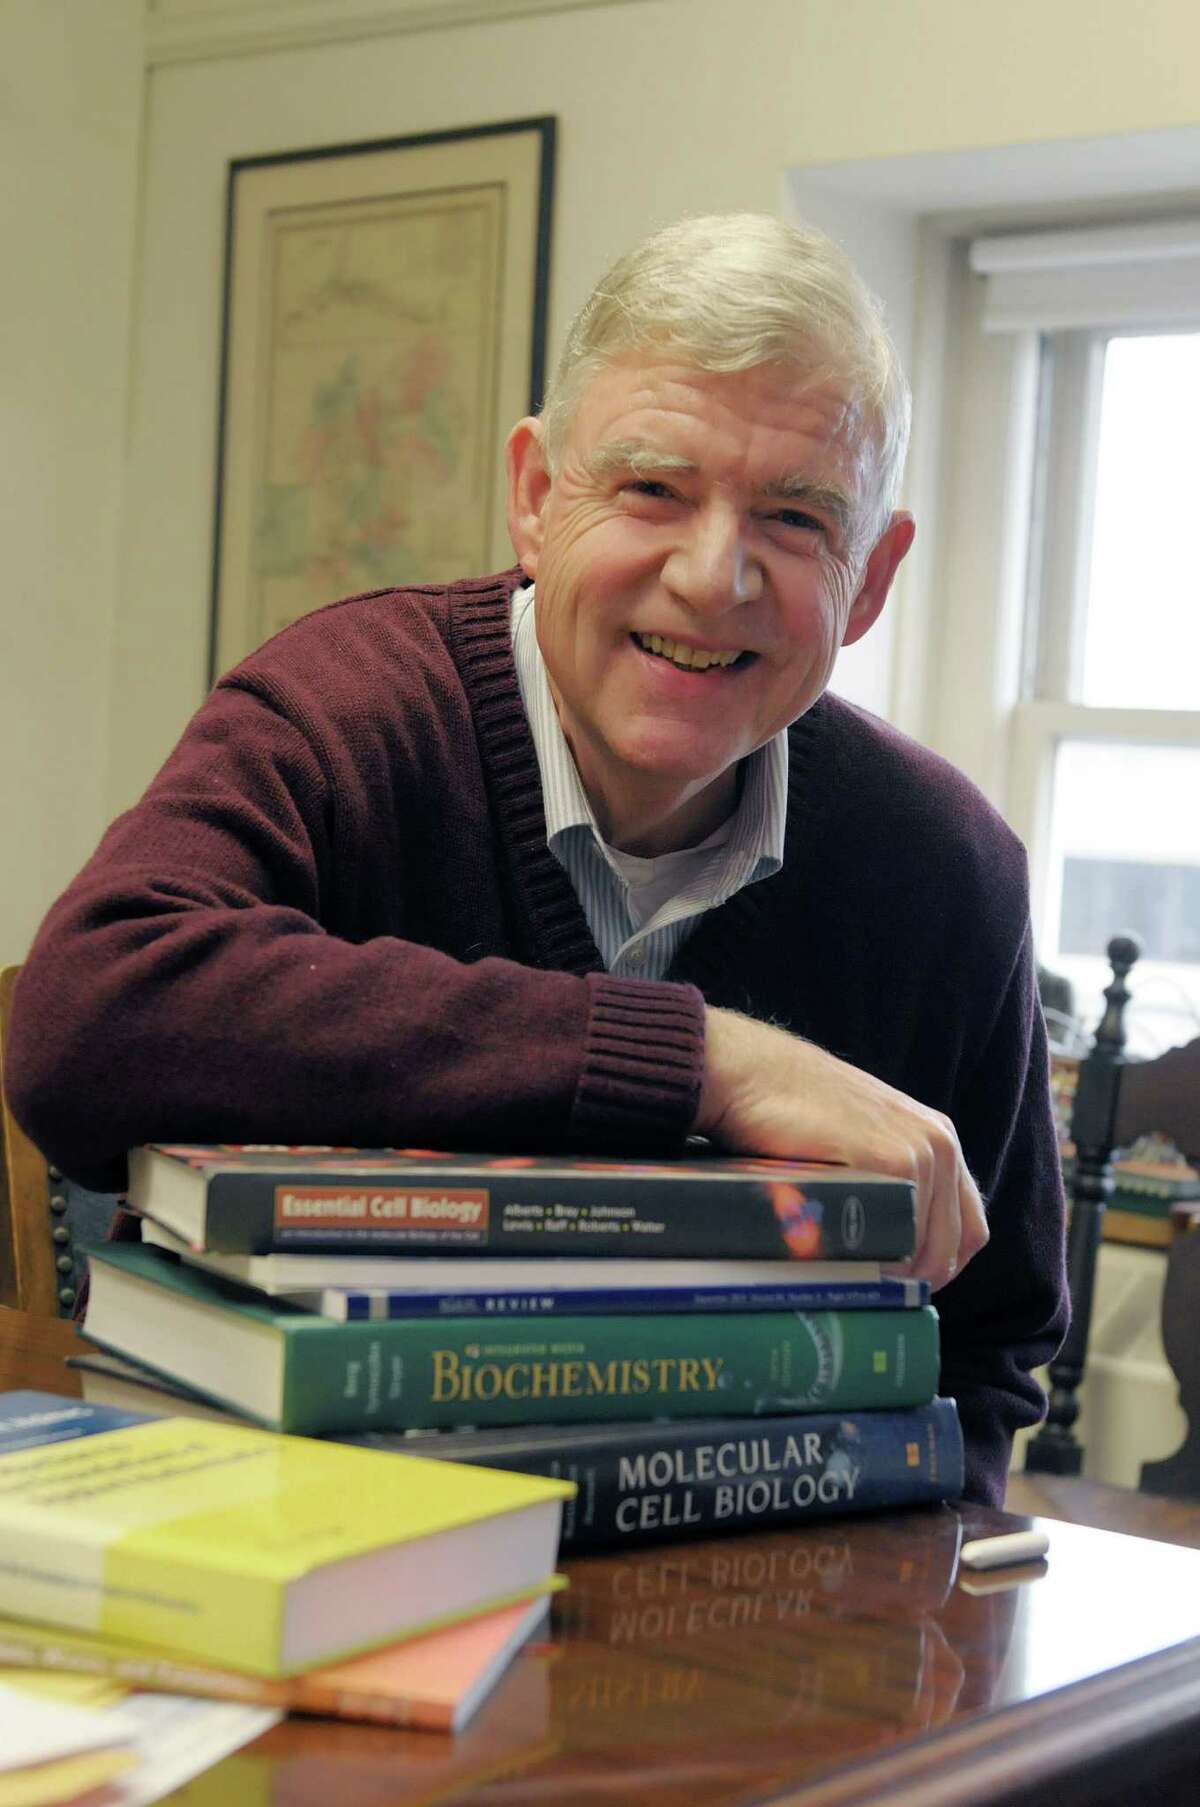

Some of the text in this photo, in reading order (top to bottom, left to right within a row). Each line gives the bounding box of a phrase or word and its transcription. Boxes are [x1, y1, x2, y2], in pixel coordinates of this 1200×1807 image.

[281, 1194, 482, 1223] Essential Cell Biology
[484, 1297, 555, 1312] REVIEW
[432, 1349, 723, 1402] BIOCHEMISTRY
[618, 1432, 823, 1492] MOLECULAR
[616, 1492, 699, 1532] CELL
[714, 1468, 860, 1519] BIOLOGY
